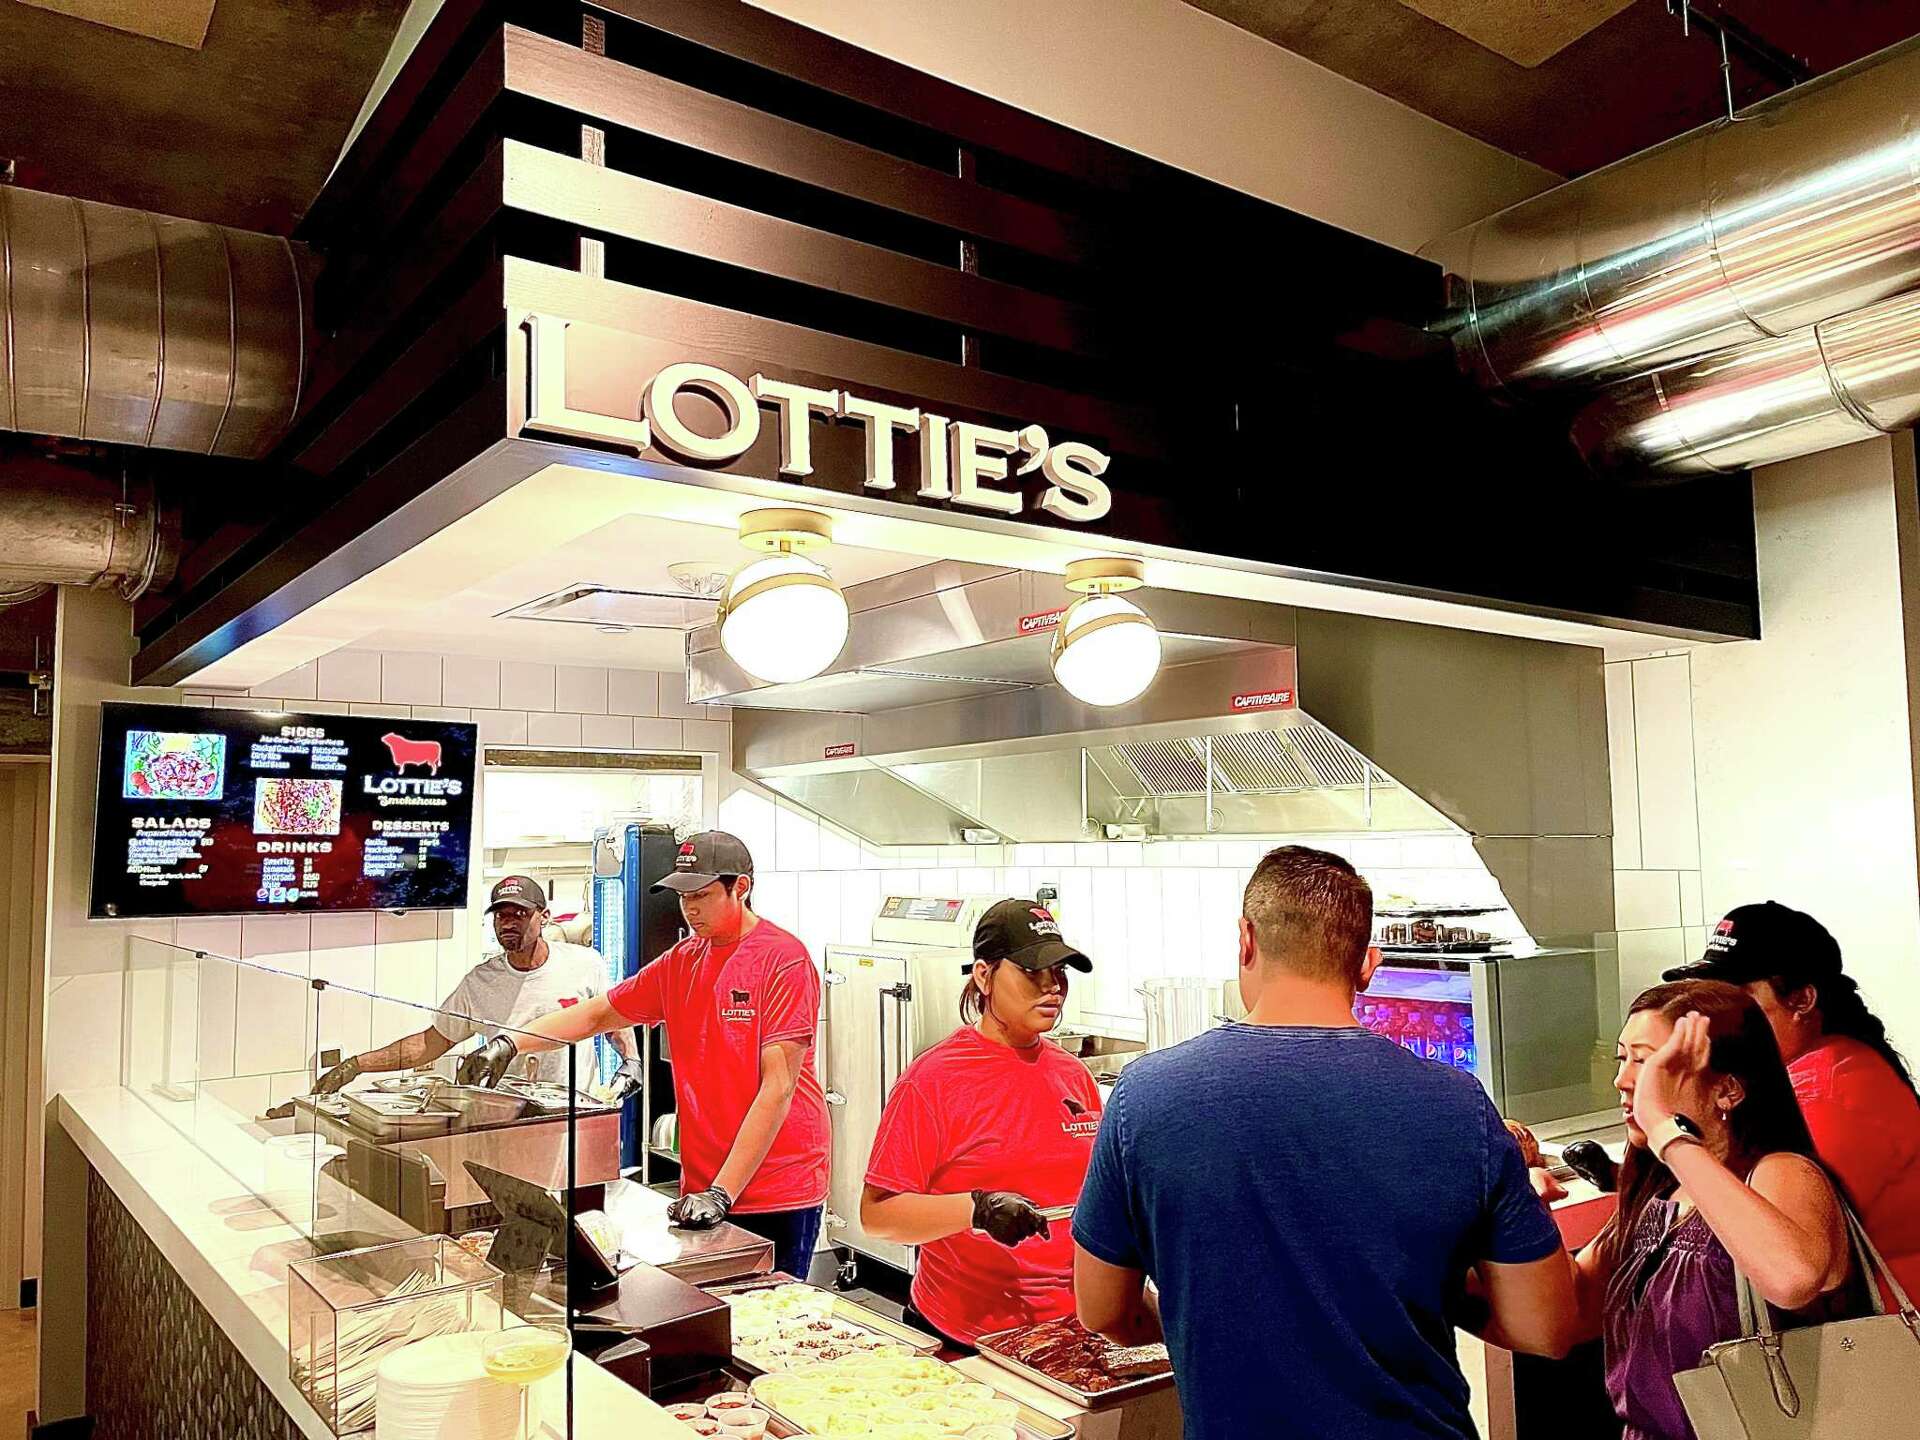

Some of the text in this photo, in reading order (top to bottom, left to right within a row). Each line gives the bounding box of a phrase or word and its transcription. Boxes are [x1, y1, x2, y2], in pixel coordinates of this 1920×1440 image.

[519, 312, 1112, 522] LOTTIE'S
[281, 726, 325, 738] SIDES
[363, 774, 463, 795] LOTTIE'S
[378, 795, 448, 807] Smokehouse
[131, 817, 212, 829] SALADS
[371, 820, 450, 831] DESSERTS
[256, 842, 333, 854] DRINKS
